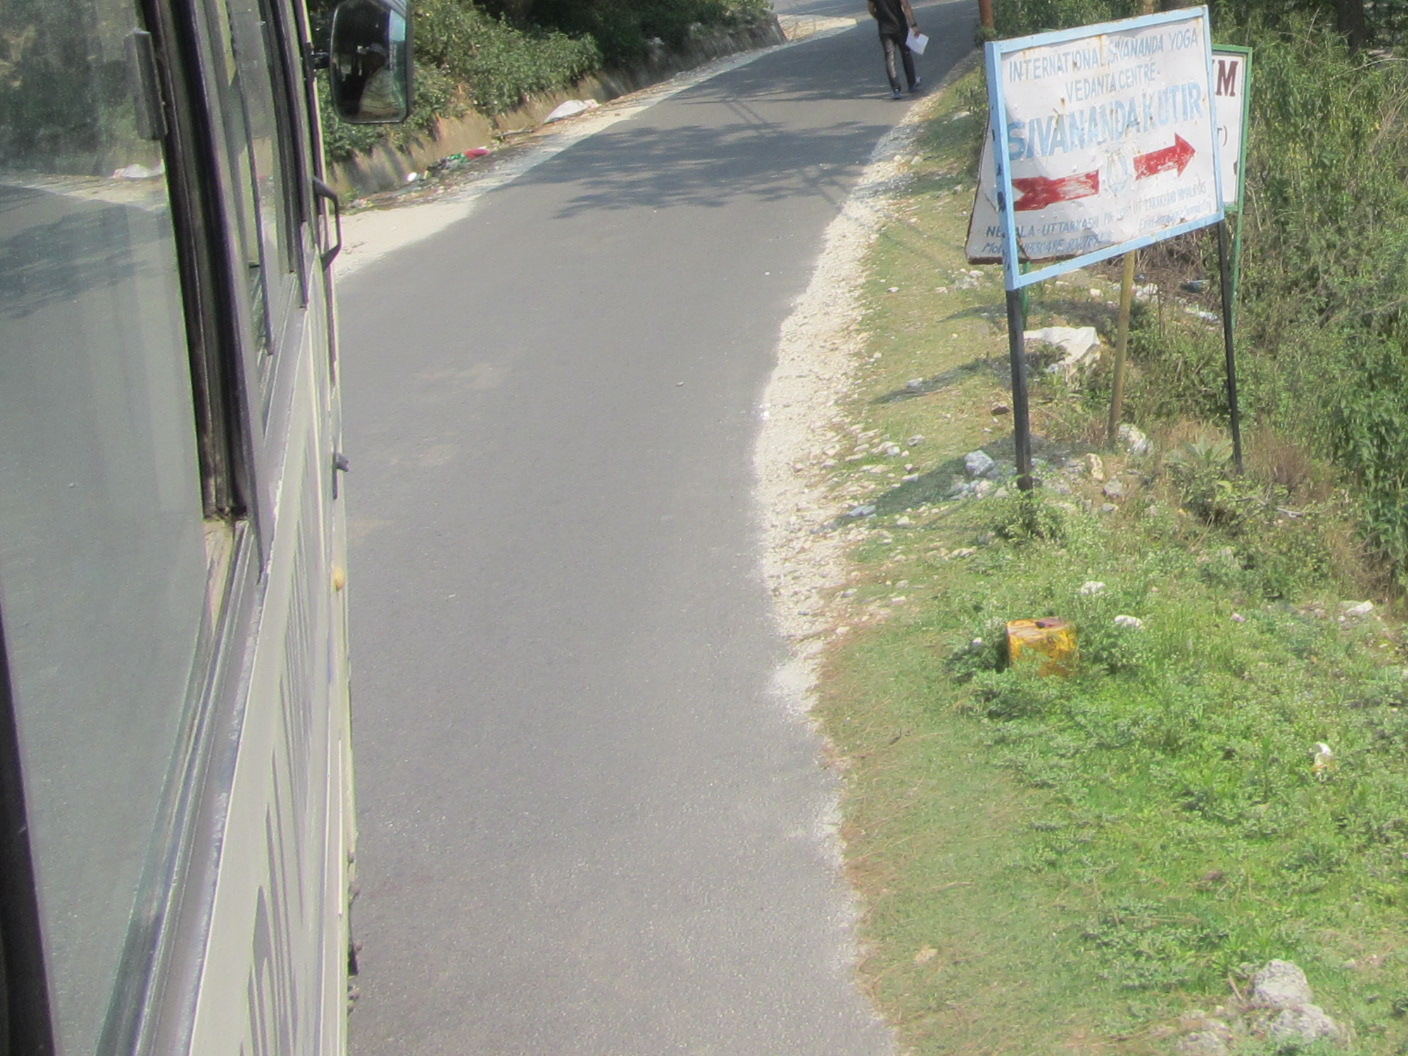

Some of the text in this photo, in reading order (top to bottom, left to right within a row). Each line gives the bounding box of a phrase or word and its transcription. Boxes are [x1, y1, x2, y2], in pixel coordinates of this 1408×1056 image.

[1009, 27, 1199, 83] INTERNATIONAL SIVANANDA YOGA
[1065, 72, 1117, 104] VEDANTA
[1142, 82, 1203, 133] KUTIR
